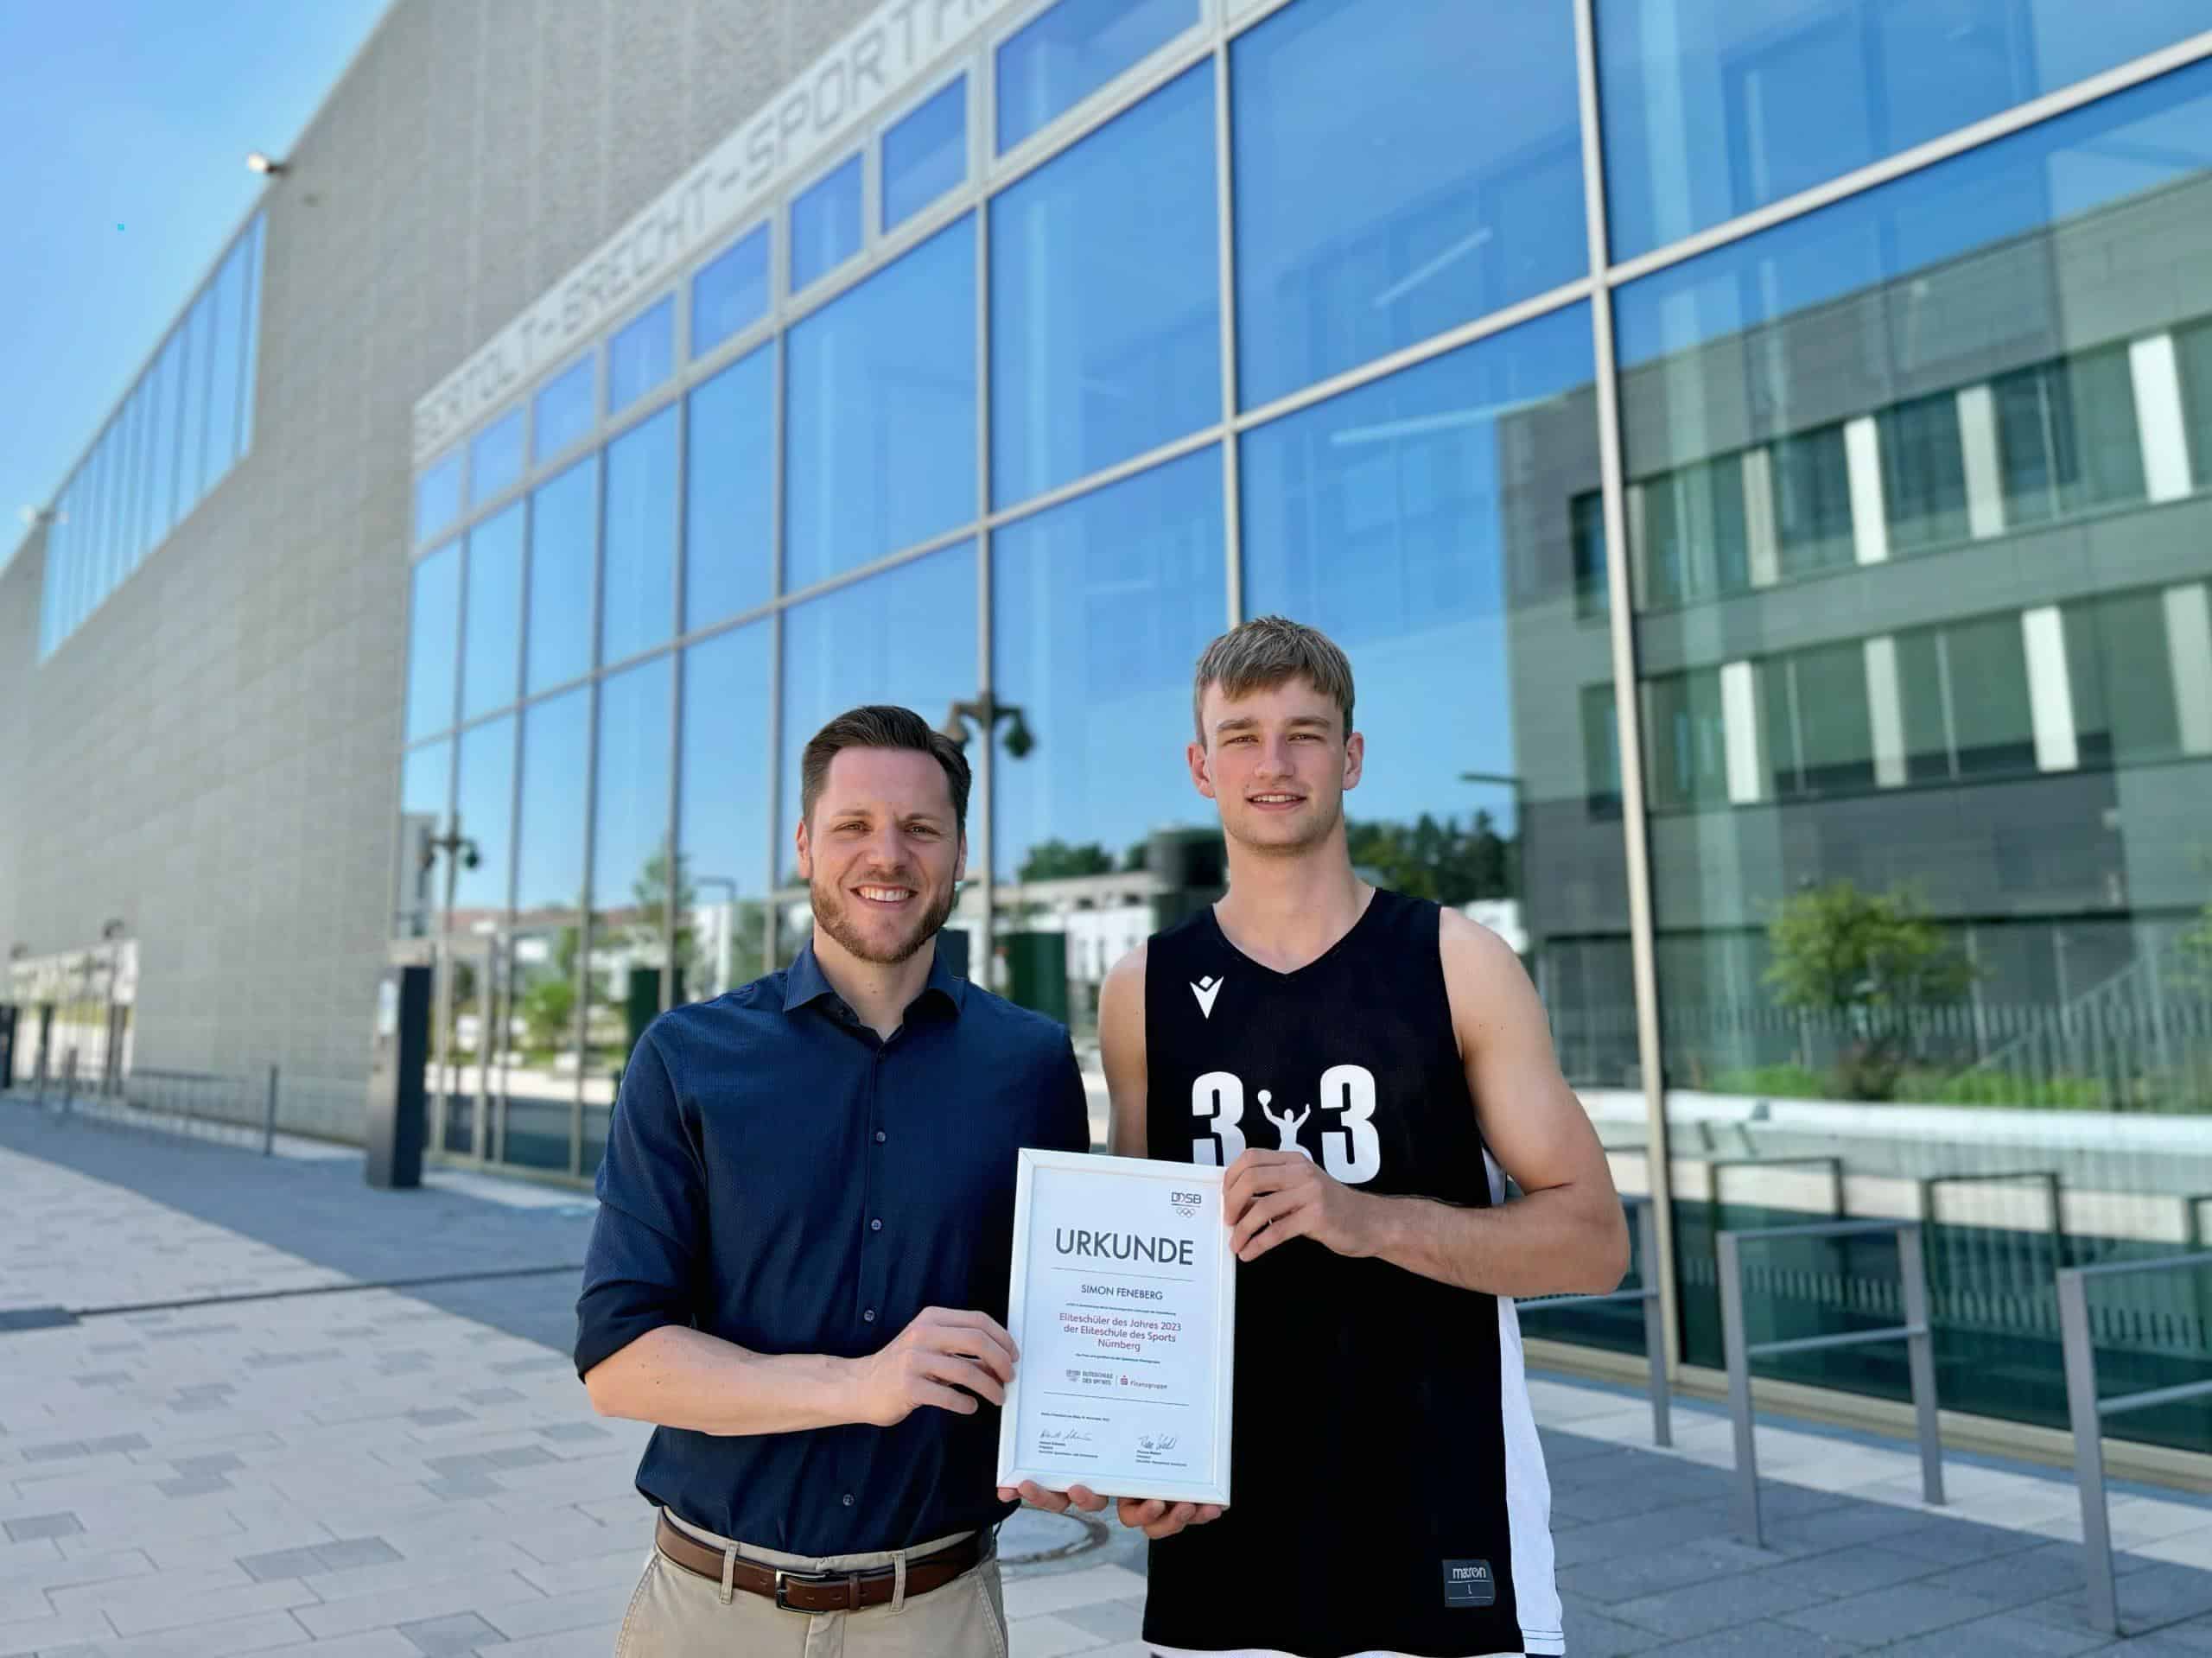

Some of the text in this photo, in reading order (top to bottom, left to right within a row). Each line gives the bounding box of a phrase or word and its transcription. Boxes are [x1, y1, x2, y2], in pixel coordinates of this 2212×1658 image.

[1192, 1064, 1381, 1184] 3 3
[1055, 1228, 1194, 1266] URKUNDE
[1081, 1284, 1163, 1300] SIMON FENEBERG
[1059, 1312, 1182, 1331] Eliteschüler des Jahres 2023
[1064, 1324, 1176, 1344] der Eliteschule des Sports
[1097, 1338, 1141, 1352] Nürnberg
